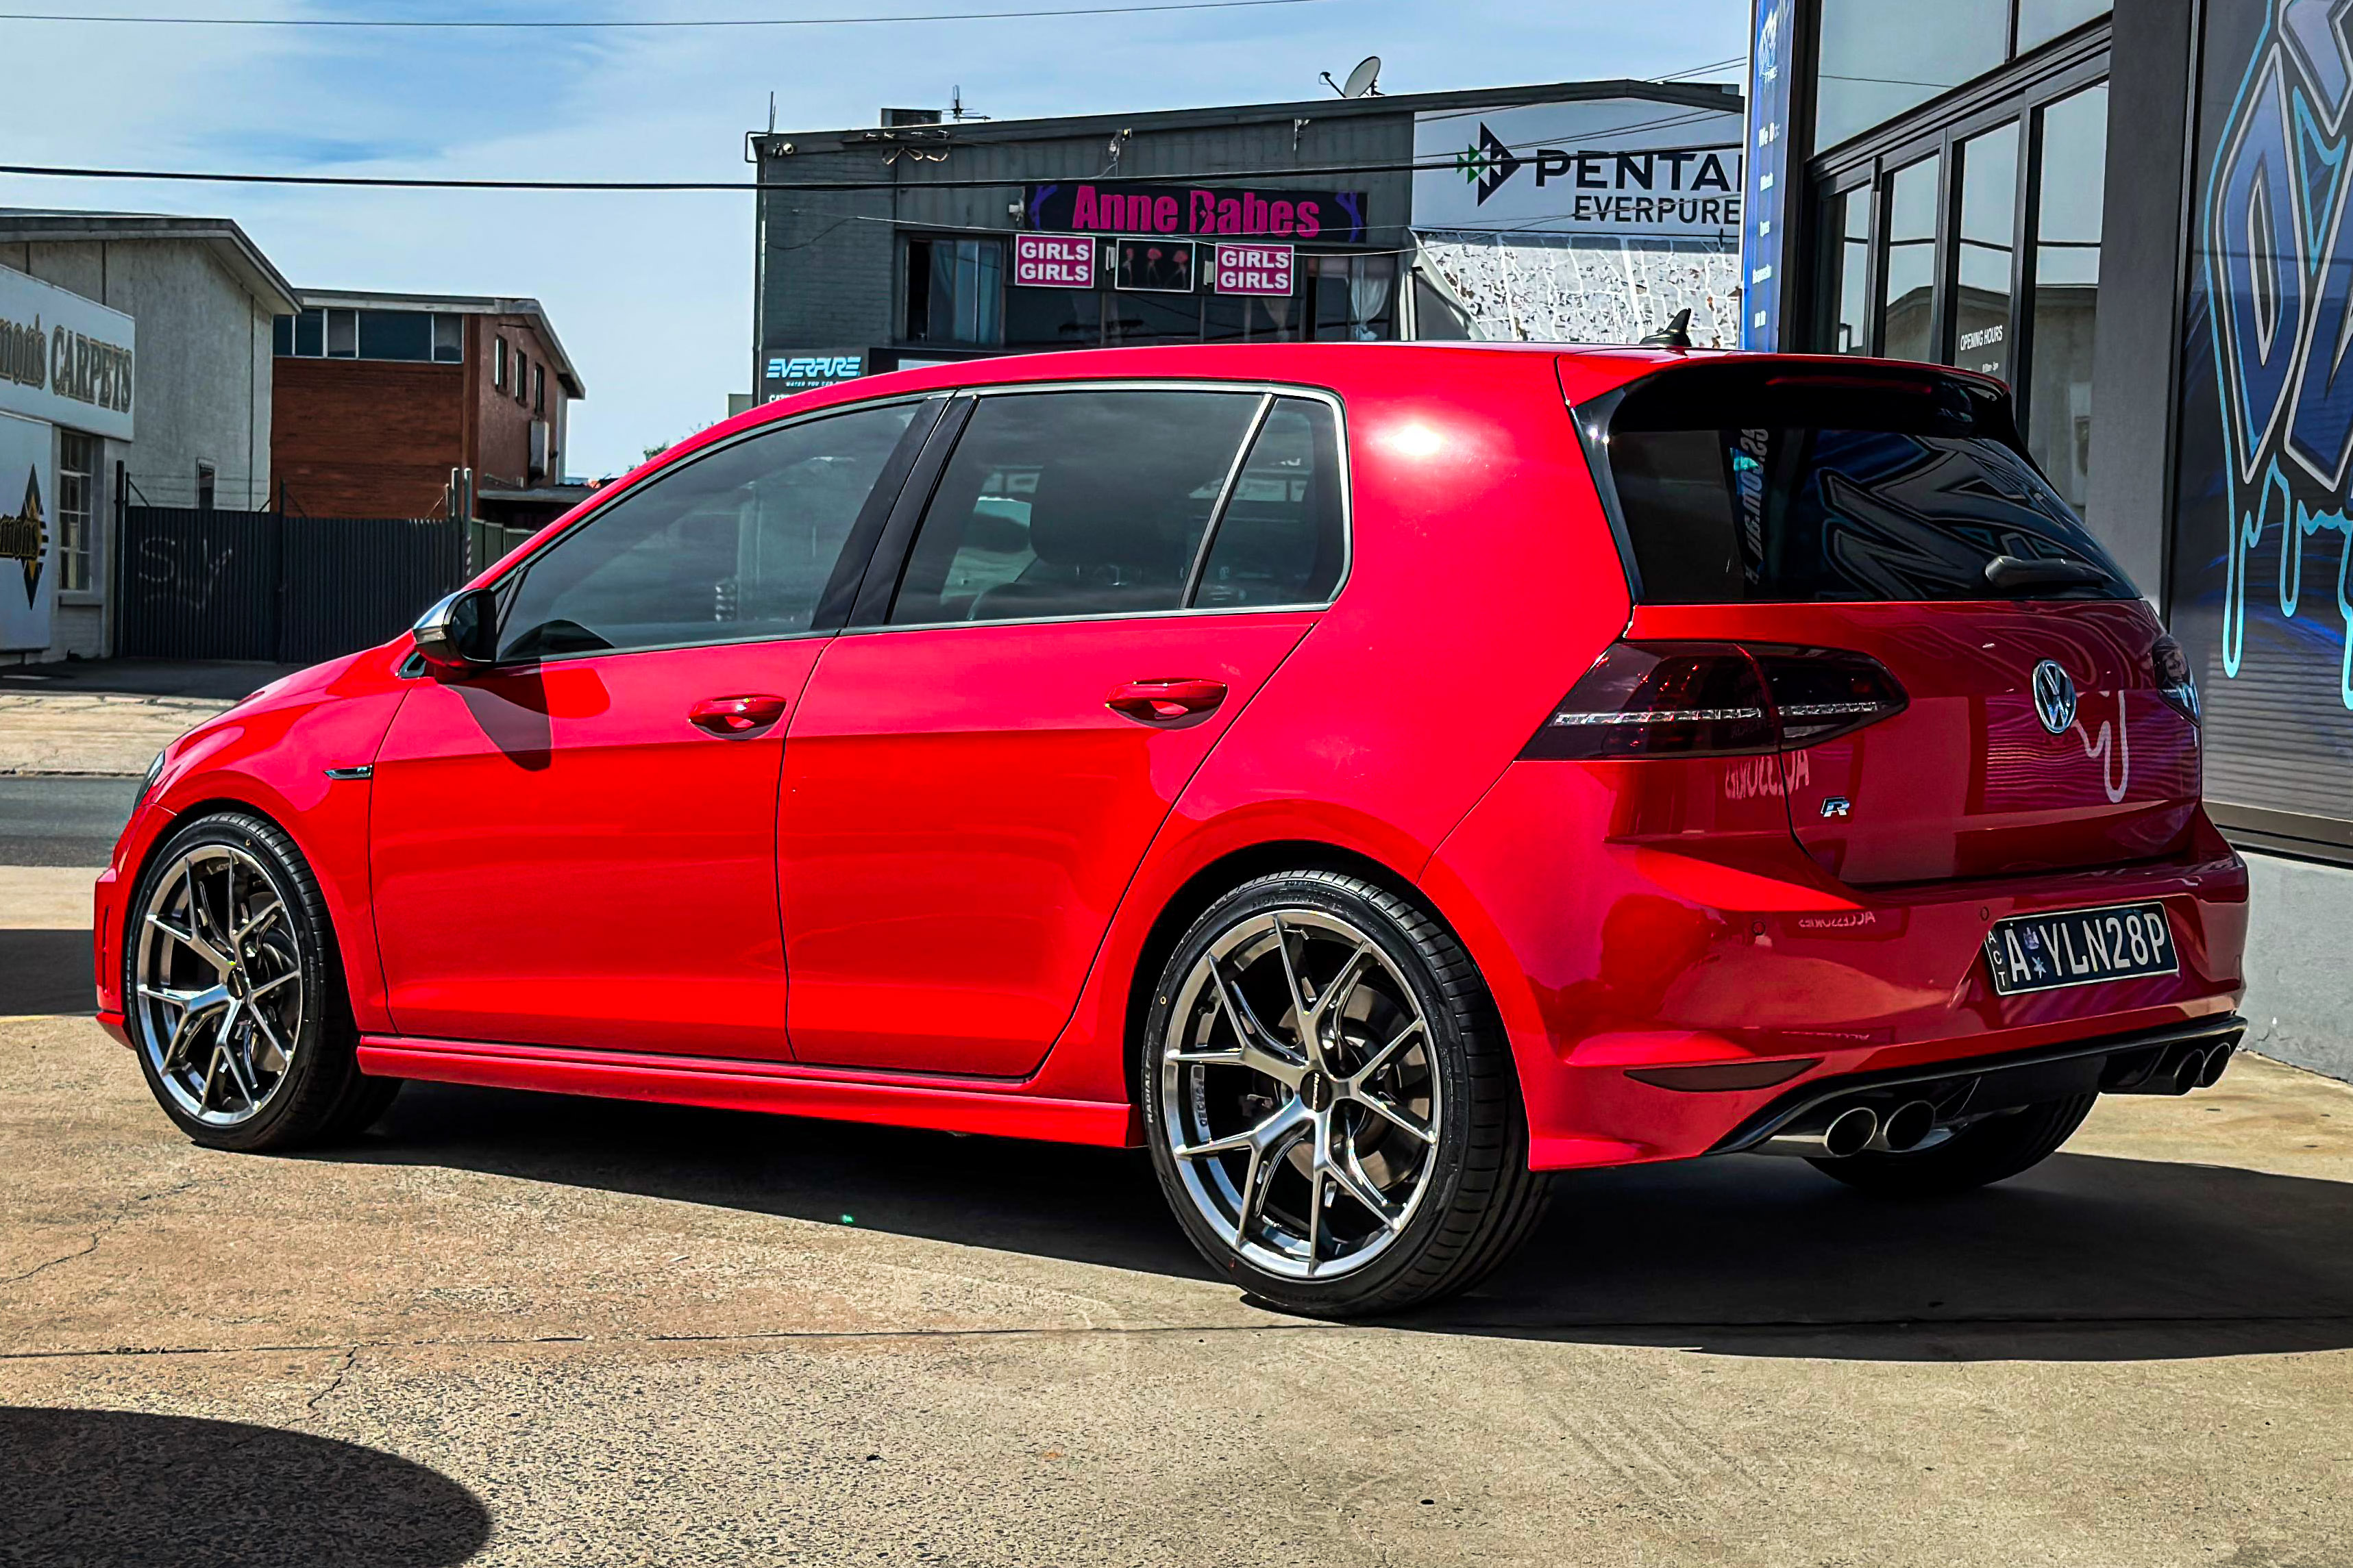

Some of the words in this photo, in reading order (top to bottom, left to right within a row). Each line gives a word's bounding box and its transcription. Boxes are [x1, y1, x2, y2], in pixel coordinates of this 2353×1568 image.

[1072, 186, 1179, 233] Anne
[1189, 190, 1321, 238] Babes
[1575, 195, 1741, 225] EVERPURE
[1020, 242, 1089, 261] GIRLS
[1220, 251, 1290, 269] GIRLS
[1020, 262, 1089, 282] GIRLS
[1220, 271, 1290, 289] GIRLS
[1960, 329, 1984, 351] OPENING
[1984, 325, 2003, 345] HOURS
[51, 324, 133, 414] CARPETS
[766, 357, 861, 377] EVERPURE
[1821, 797, 1850, 817] R
[1988, 931, 2006, 986] ACT
